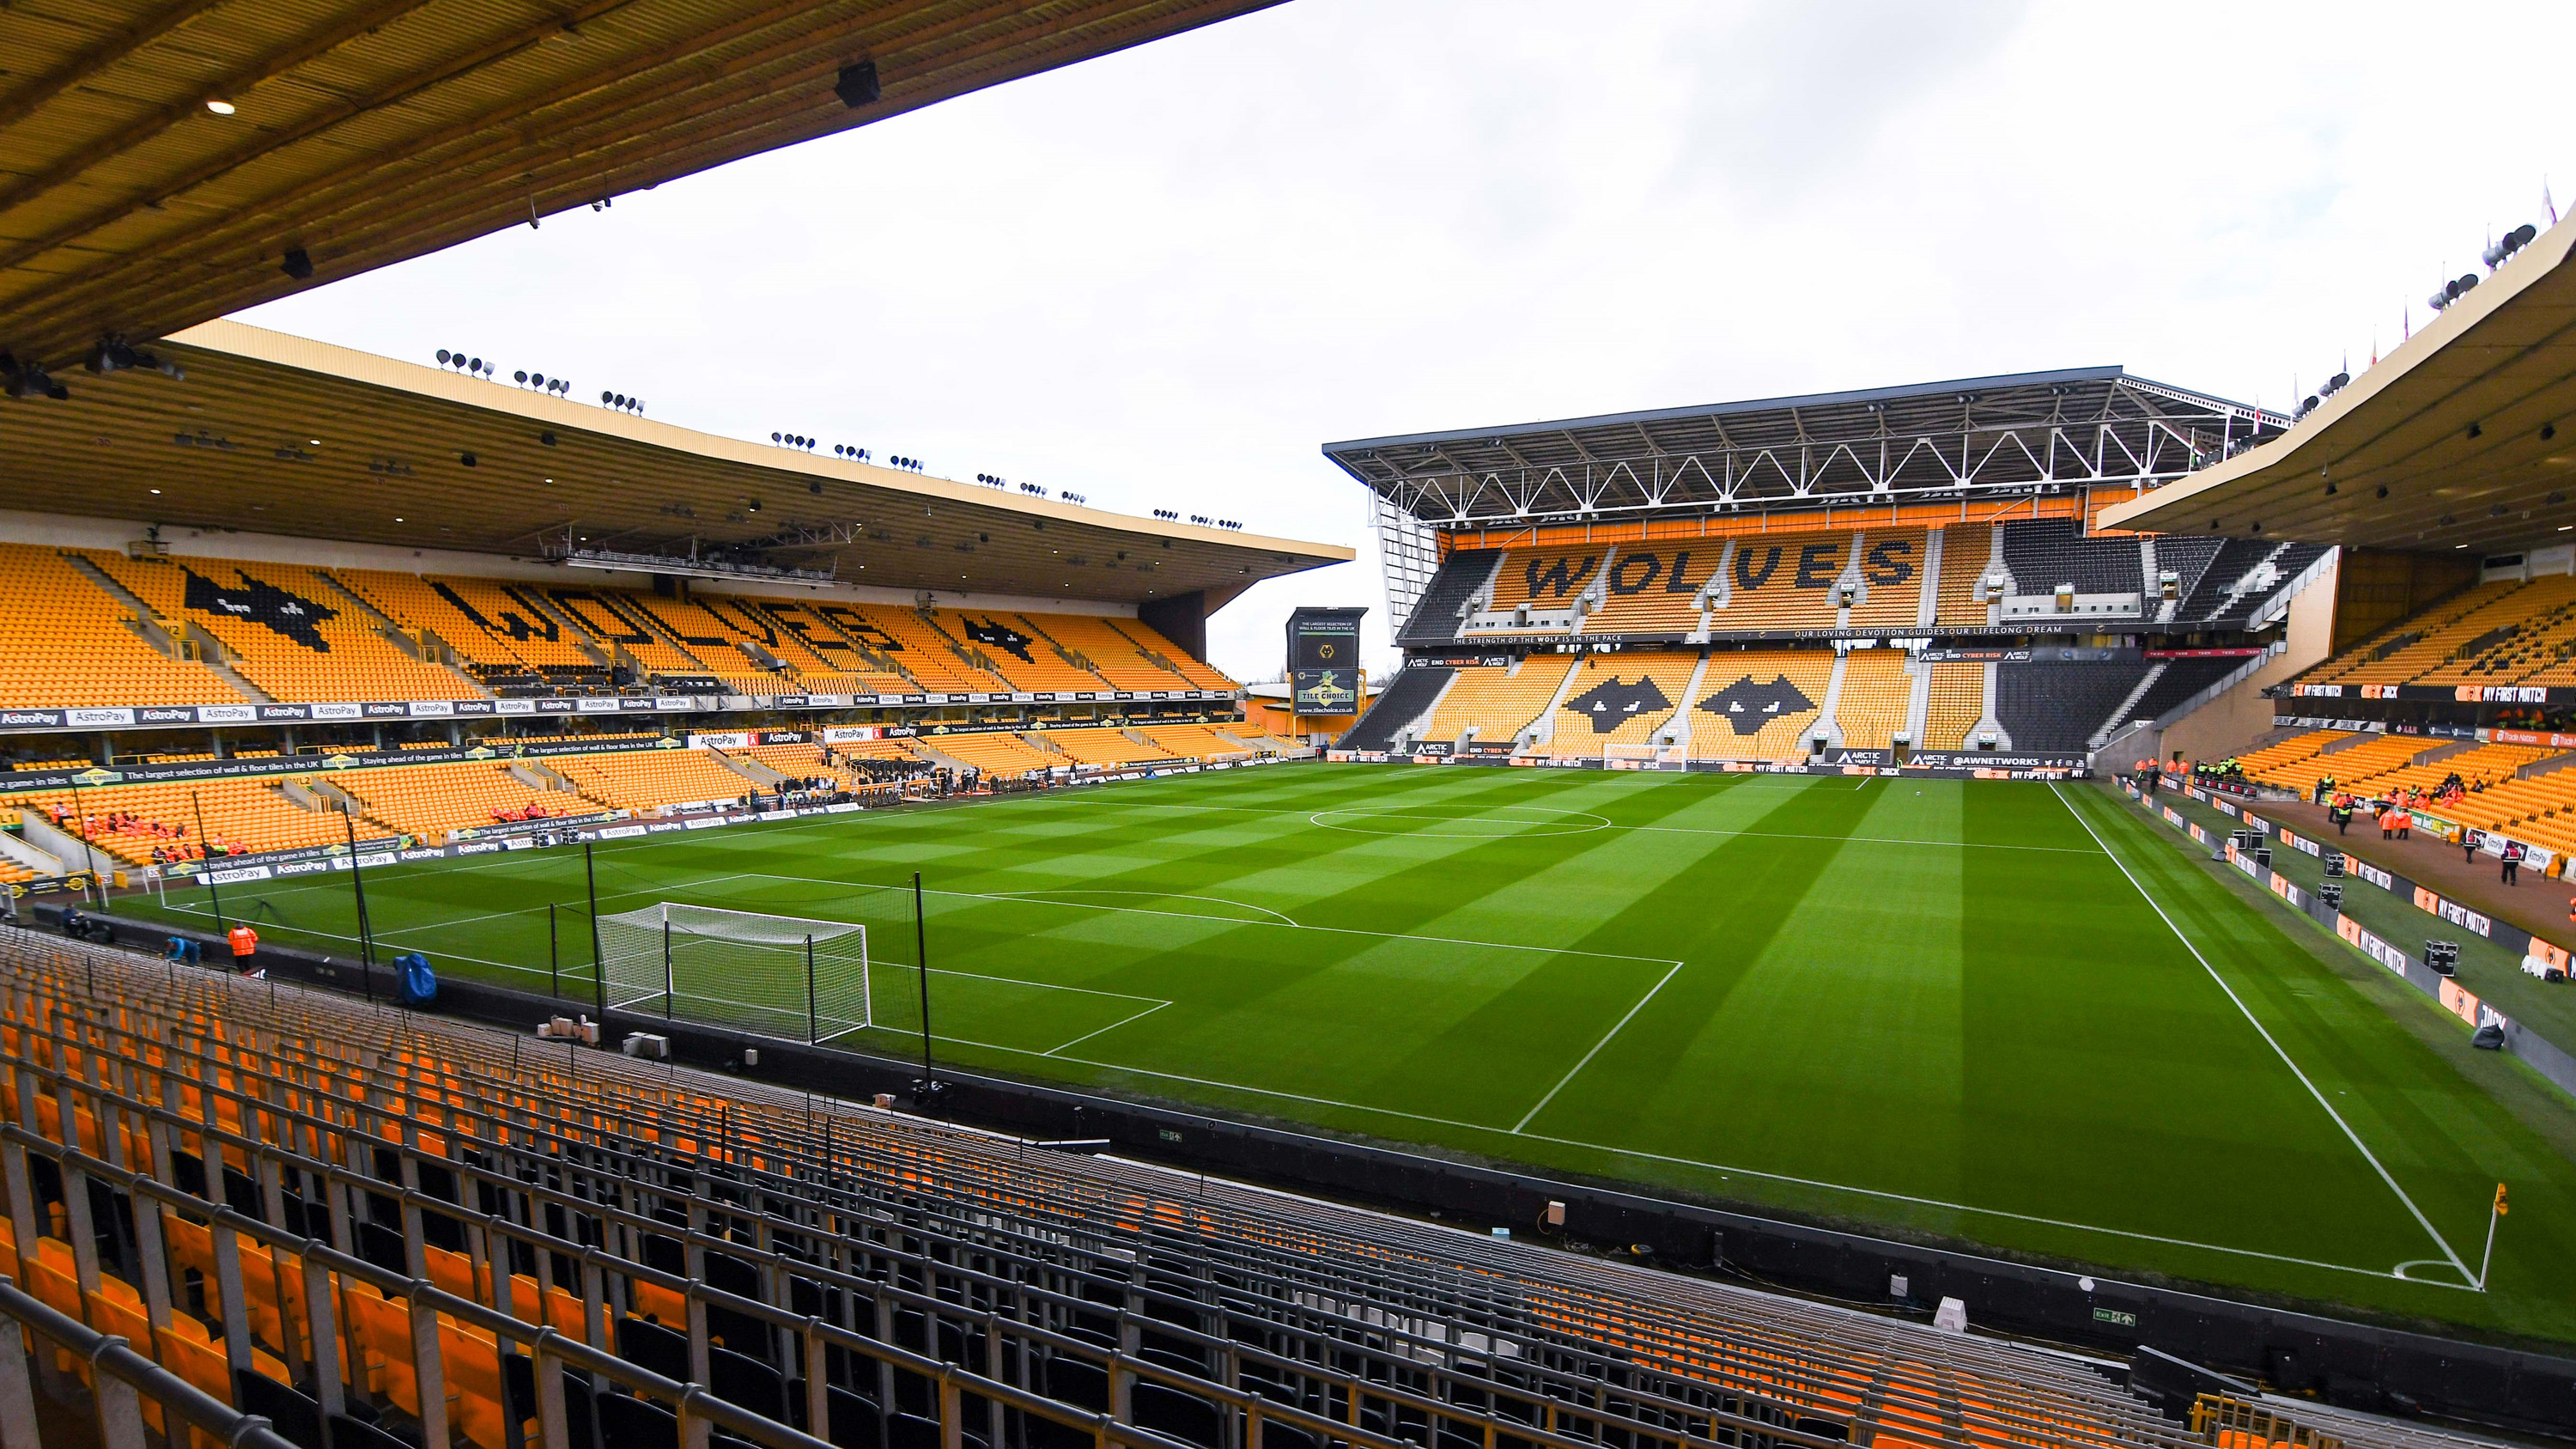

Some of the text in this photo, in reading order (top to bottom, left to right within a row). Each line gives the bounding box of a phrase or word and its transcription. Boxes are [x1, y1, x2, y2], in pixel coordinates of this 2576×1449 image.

[1525, 540, 1913, 599] WOLVES
[2382, 685, 2398, 698] JACK
[2483, 686, 2548, 703] MY FIRST MATCH
[541, 700, 571, 711] AstroPay
[623, 699, 653, 709] AstroPay
[782, 697, 805, 705] AstroPay
[811, 696, 834, 705] AstroPay
[856, 696, 877, 704] AstroPay
[263, 706, 306, 718] AstroPay
[318, 705, 356, 716] AstroPay
[368, 704, 404, 715] AstroPay
[459, 702, 491, 712] AstroPay
[2, 712, 59, 725] AstroPay
[75, 710, 126, 722] AstroPay
[143, 709, 191, 721] AstroPay
[205, 708, 250, 719] AstroPay
[768, 732, 803, 743] AstroPay
[835, 729, 864, 740] AstroPay
[889, 727, 917, 737] AstroPay
[2504, 732, 2537, 742] Trade Nation
[700, 734, 737, 746] AstroPay
[1953, 756, 2039, 765] @AWNETWORKS
[145, 770, 174, 780] largest
[175, 768, 212, 776] selection
[1755, 764, 1807, 773] MY FIRST MATCH
[1880, 767, 1900, 776] JACK
[2012, 770, 2023, 779] MY
[7, 780, 34, 789] game
[47, 776, 68, 785] tiles
[649, 822, 681, 832] AstroPay
[690, 817, 720, 827] AstroPay
[490, 826, 509, 837] largest
[510, 824, 532, 832] selection
[606, 827, 639, 837] AstroPay
[458, 842, 499, 853] AstroPay
[234, 857, 255, 867] ahead
[265, 854, 277, 862] the
[279, 852, 297, 863] game
[401, 848, 445, 860] AstroPay
[276, 861, 327, 874] AstroPay
[2358, 861, 2392, 891] MY FIRST MATCH
[2438, 898, 2491, 938] MY FIRST MATCH
[2360, 929, 2406, 977] MY FIRST MATCH
